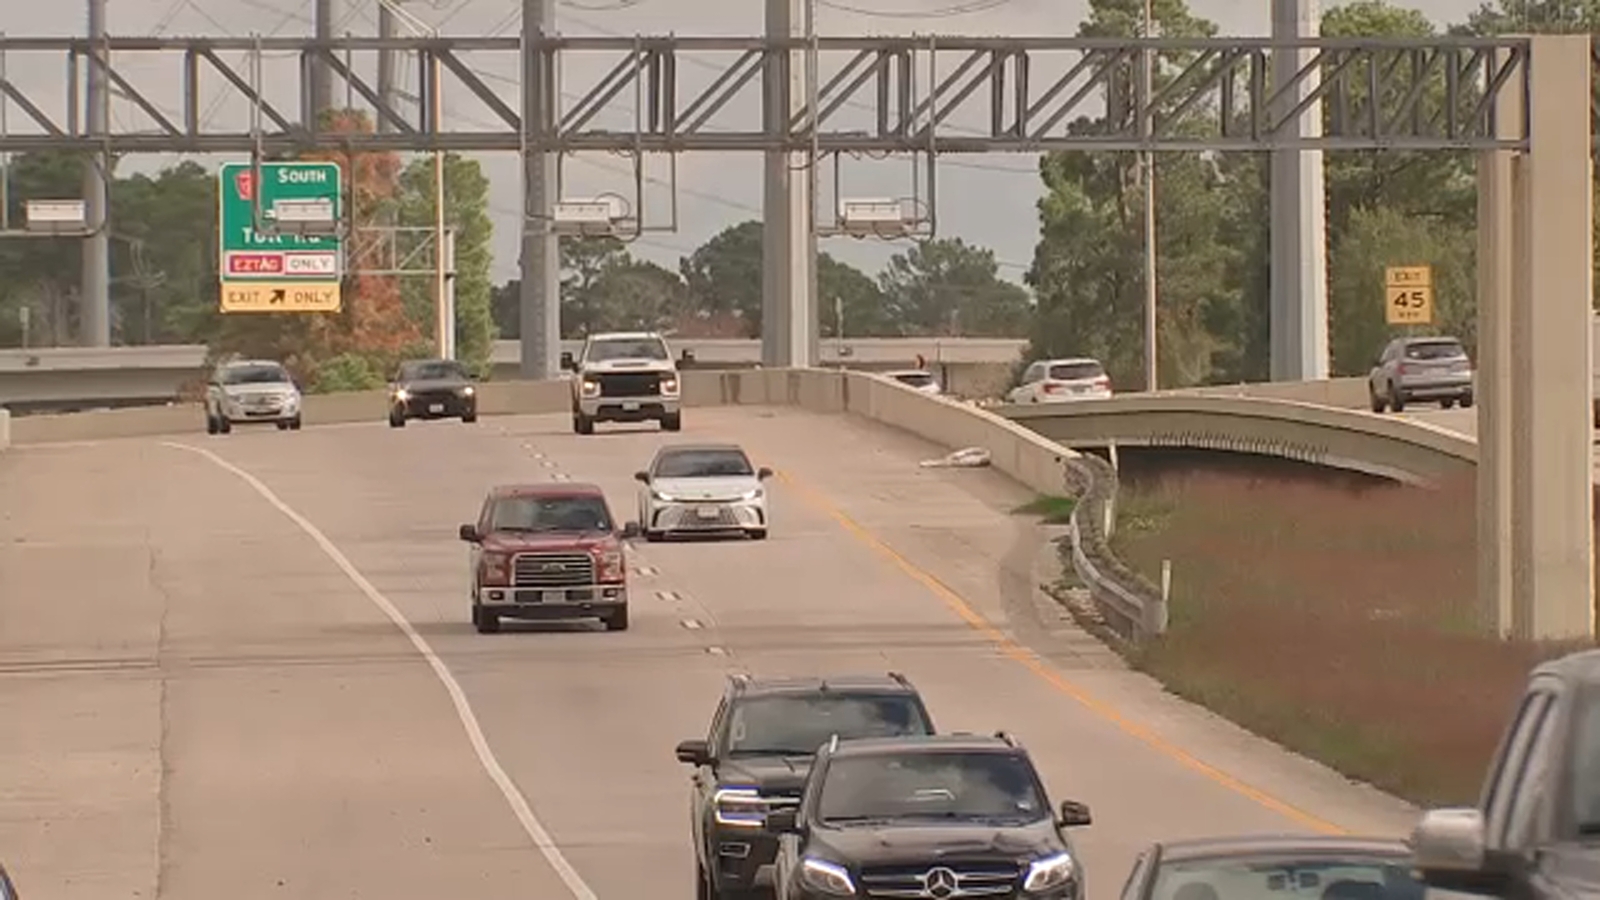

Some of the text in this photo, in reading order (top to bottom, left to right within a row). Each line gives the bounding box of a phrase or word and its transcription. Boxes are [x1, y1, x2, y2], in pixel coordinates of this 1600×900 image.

[290, 258, 331, 271] ONLY
[228, 291, 334, 303] EXIT ONLY
[1394, 291, 1426, 308] 45
